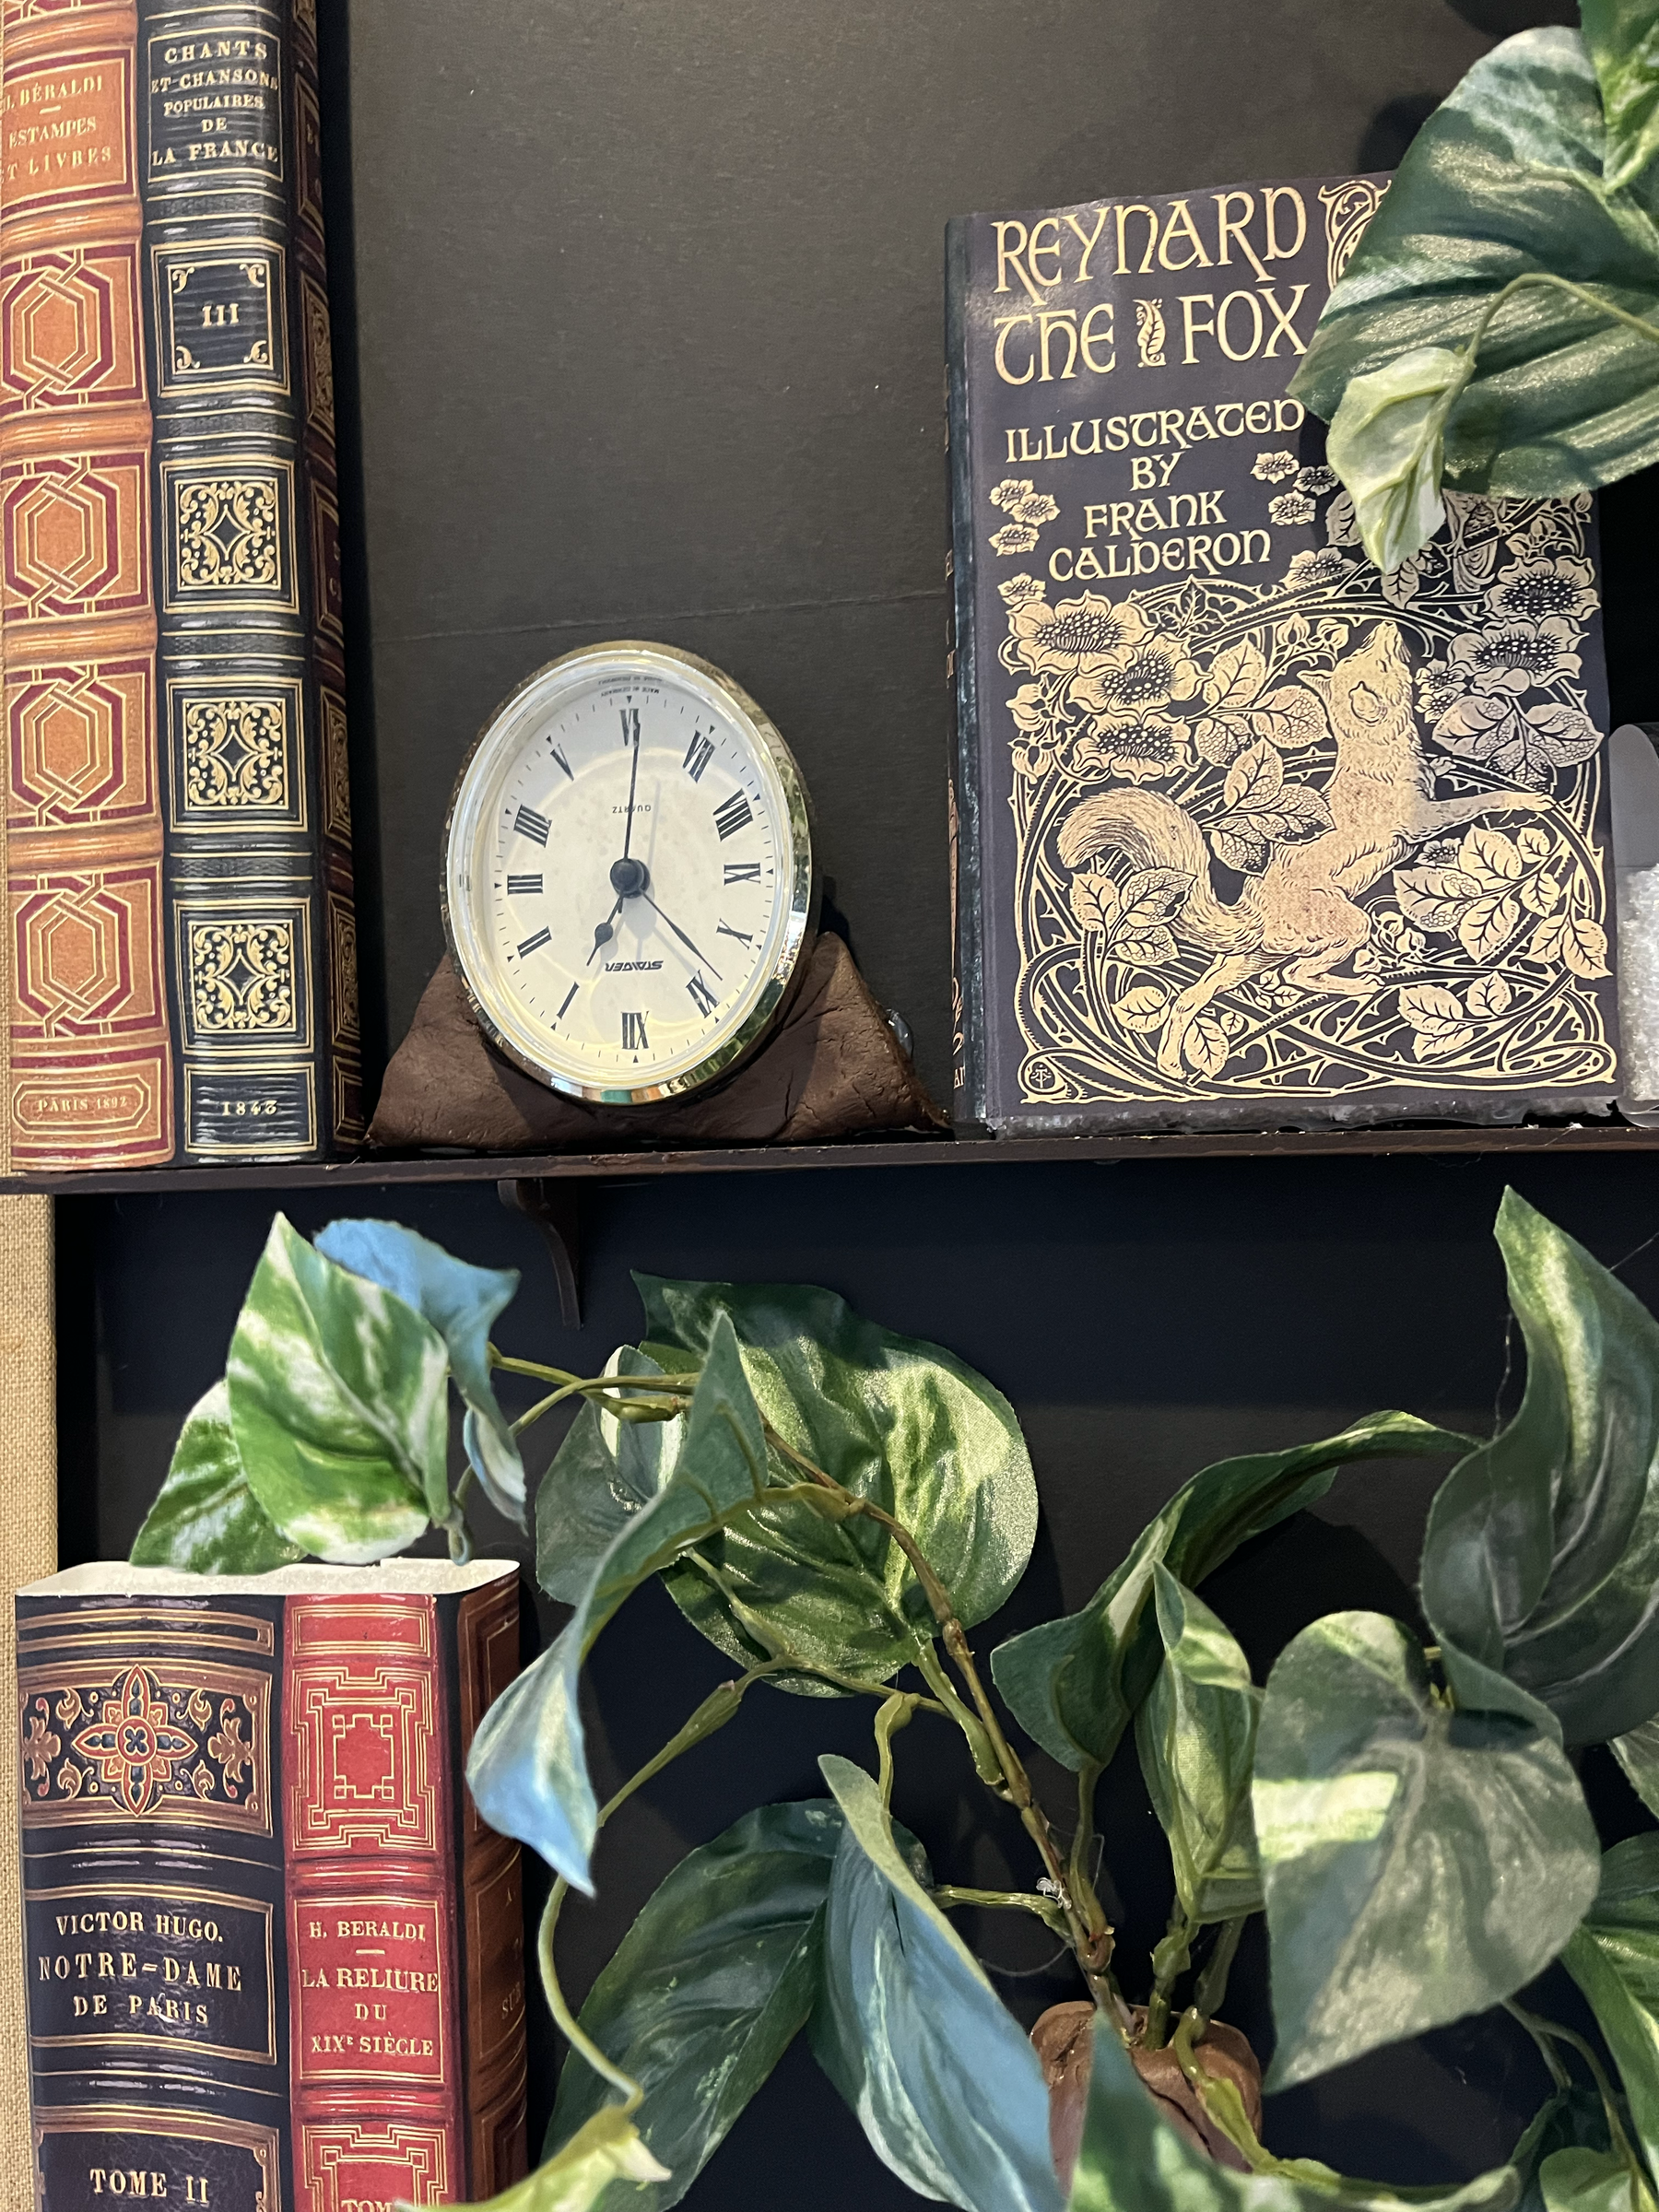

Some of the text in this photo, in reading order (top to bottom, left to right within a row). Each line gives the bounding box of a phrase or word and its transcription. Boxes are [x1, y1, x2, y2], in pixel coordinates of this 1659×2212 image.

[164, 40, 268, 65] CHANTS
[19, 76, 102, 107] BÉRALDI
[151, 76, 172, 94] ET
[163, 94, 266, 117] POPULAIRES
[8, 115, 97, 149] ESTAMPES
[201, 117, 228, 133] DE
[29, 146, 112, 176] LIVRES
[151, 139, 279, 167] LA FRANCE
[990, 186, 1308, 307] REYNARD
[201, 302, 240, 327] III
[993, 283, 1312, 385] THE FOX
[1005, 397, 1307, 463] ILLUSTRATED
[1130, 450, 1186, 491] BY
[1084, 489, 1227, 541] FRANK
[1048, 528, 1272, 582] CALDERON
[38, 1095, 128, 1112] PARIS 1892
[221, 1100, 278, 1118] 1843
[55, 1911, 224, 1943] VICTOR HUGO.
[309, 1921, 426, 1942] H. BERALDI
[302, 1968, 439, 1993] LA RELIURE
[73, 1994, 209, 2027] DE PARIS
[354, 2003, 388, 2022] DU
[359, 2030, 434, 2056] SIÈCLE
[89, 2168, 209, 2204] TOME II
